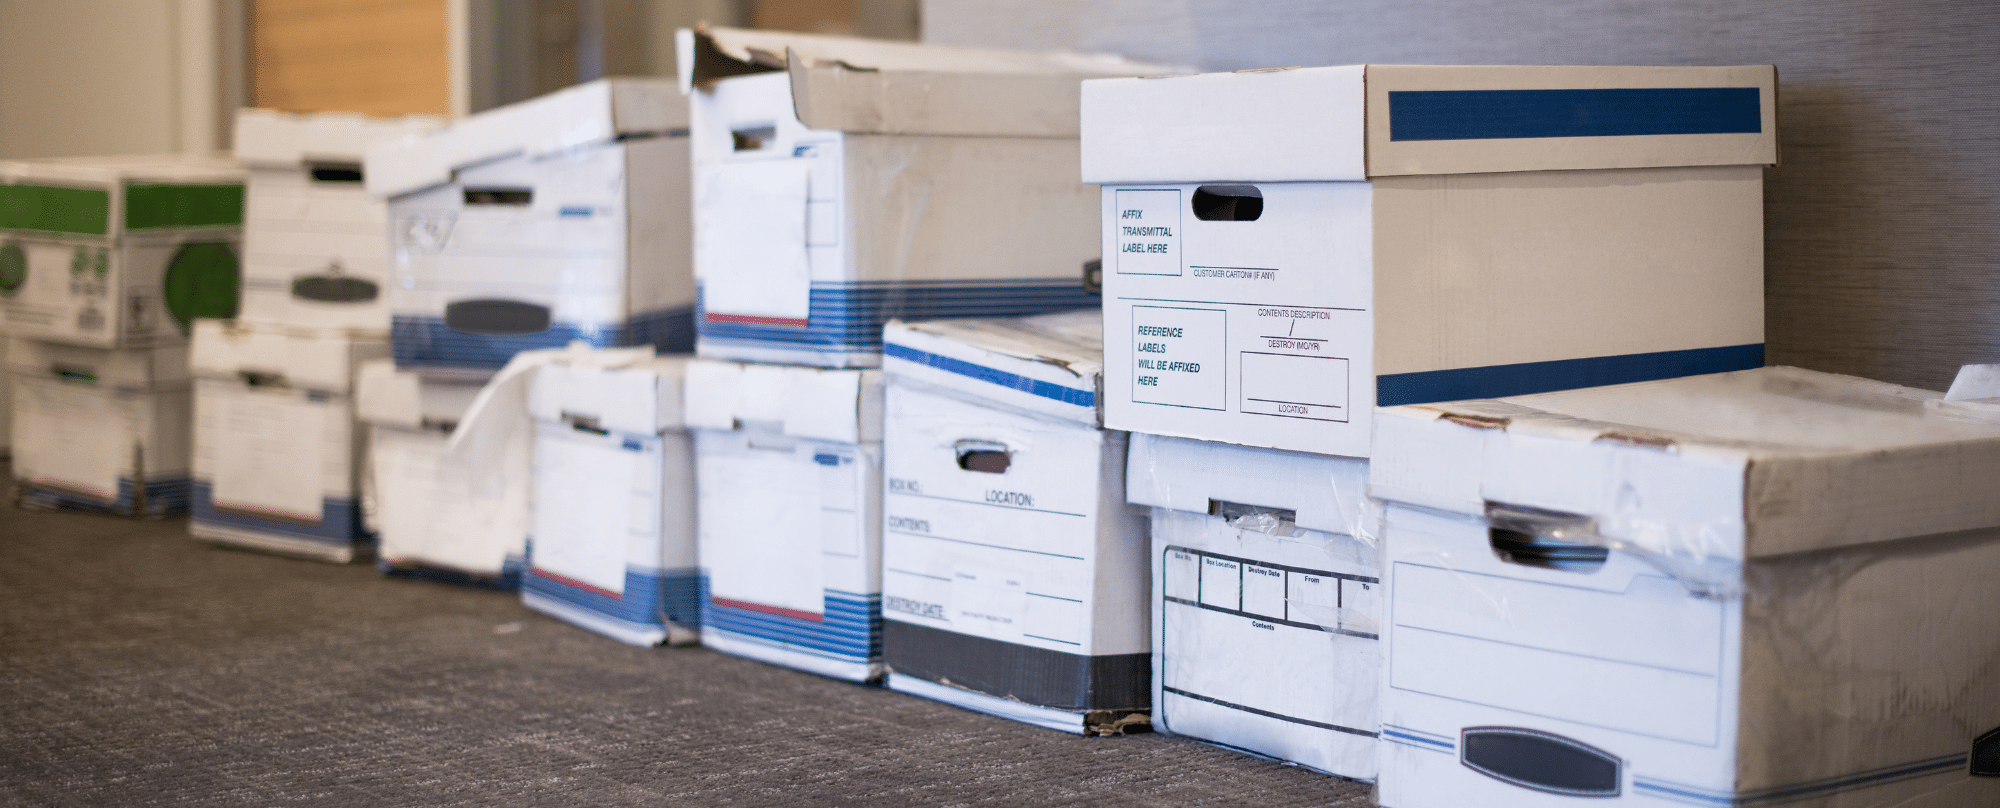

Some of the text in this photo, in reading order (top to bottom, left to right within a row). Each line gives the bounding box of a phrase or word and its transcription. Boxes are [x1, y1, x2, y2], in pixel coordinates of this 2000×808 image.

[1122, 209, 1143, 219] AFFIX
[1122, 226, 1173, 237] TRANSMITTAL
[1122, 243, 1168, 254] LABEL HERE
[1193, 269, 1225, 278] CUSTOMER
[1226, 270, 1253, 279] CARTON#
[1261, 271, 1275, 281] ANY)
[1257, 308, 1331, 320] CONTENTS DESCRIPTION
[1137, 325, 1183, 338] REFERENCE
[1137, 342, 1166, 354] LABELS
[1268, 340, 1320, 352] DESTROY (MO/YR)
[1138, 358, 1201, 373] WILL BE AFFIXED
[1137, 375, 1159, 387] HERE
[1278, 404, 1309, 415] LOCATION
[889, 478, 905, 490] BOX
[985, 489, 1035, 507] LOCATION:
[1206, 558, 1237, 570] Box Location
[1248, 566, 1281, 578] Destroy Date
[1304, 575, 1320, 584] From
[1362, 583, 1370, 591] To
[1251, 620, 1275, 631] Contents
